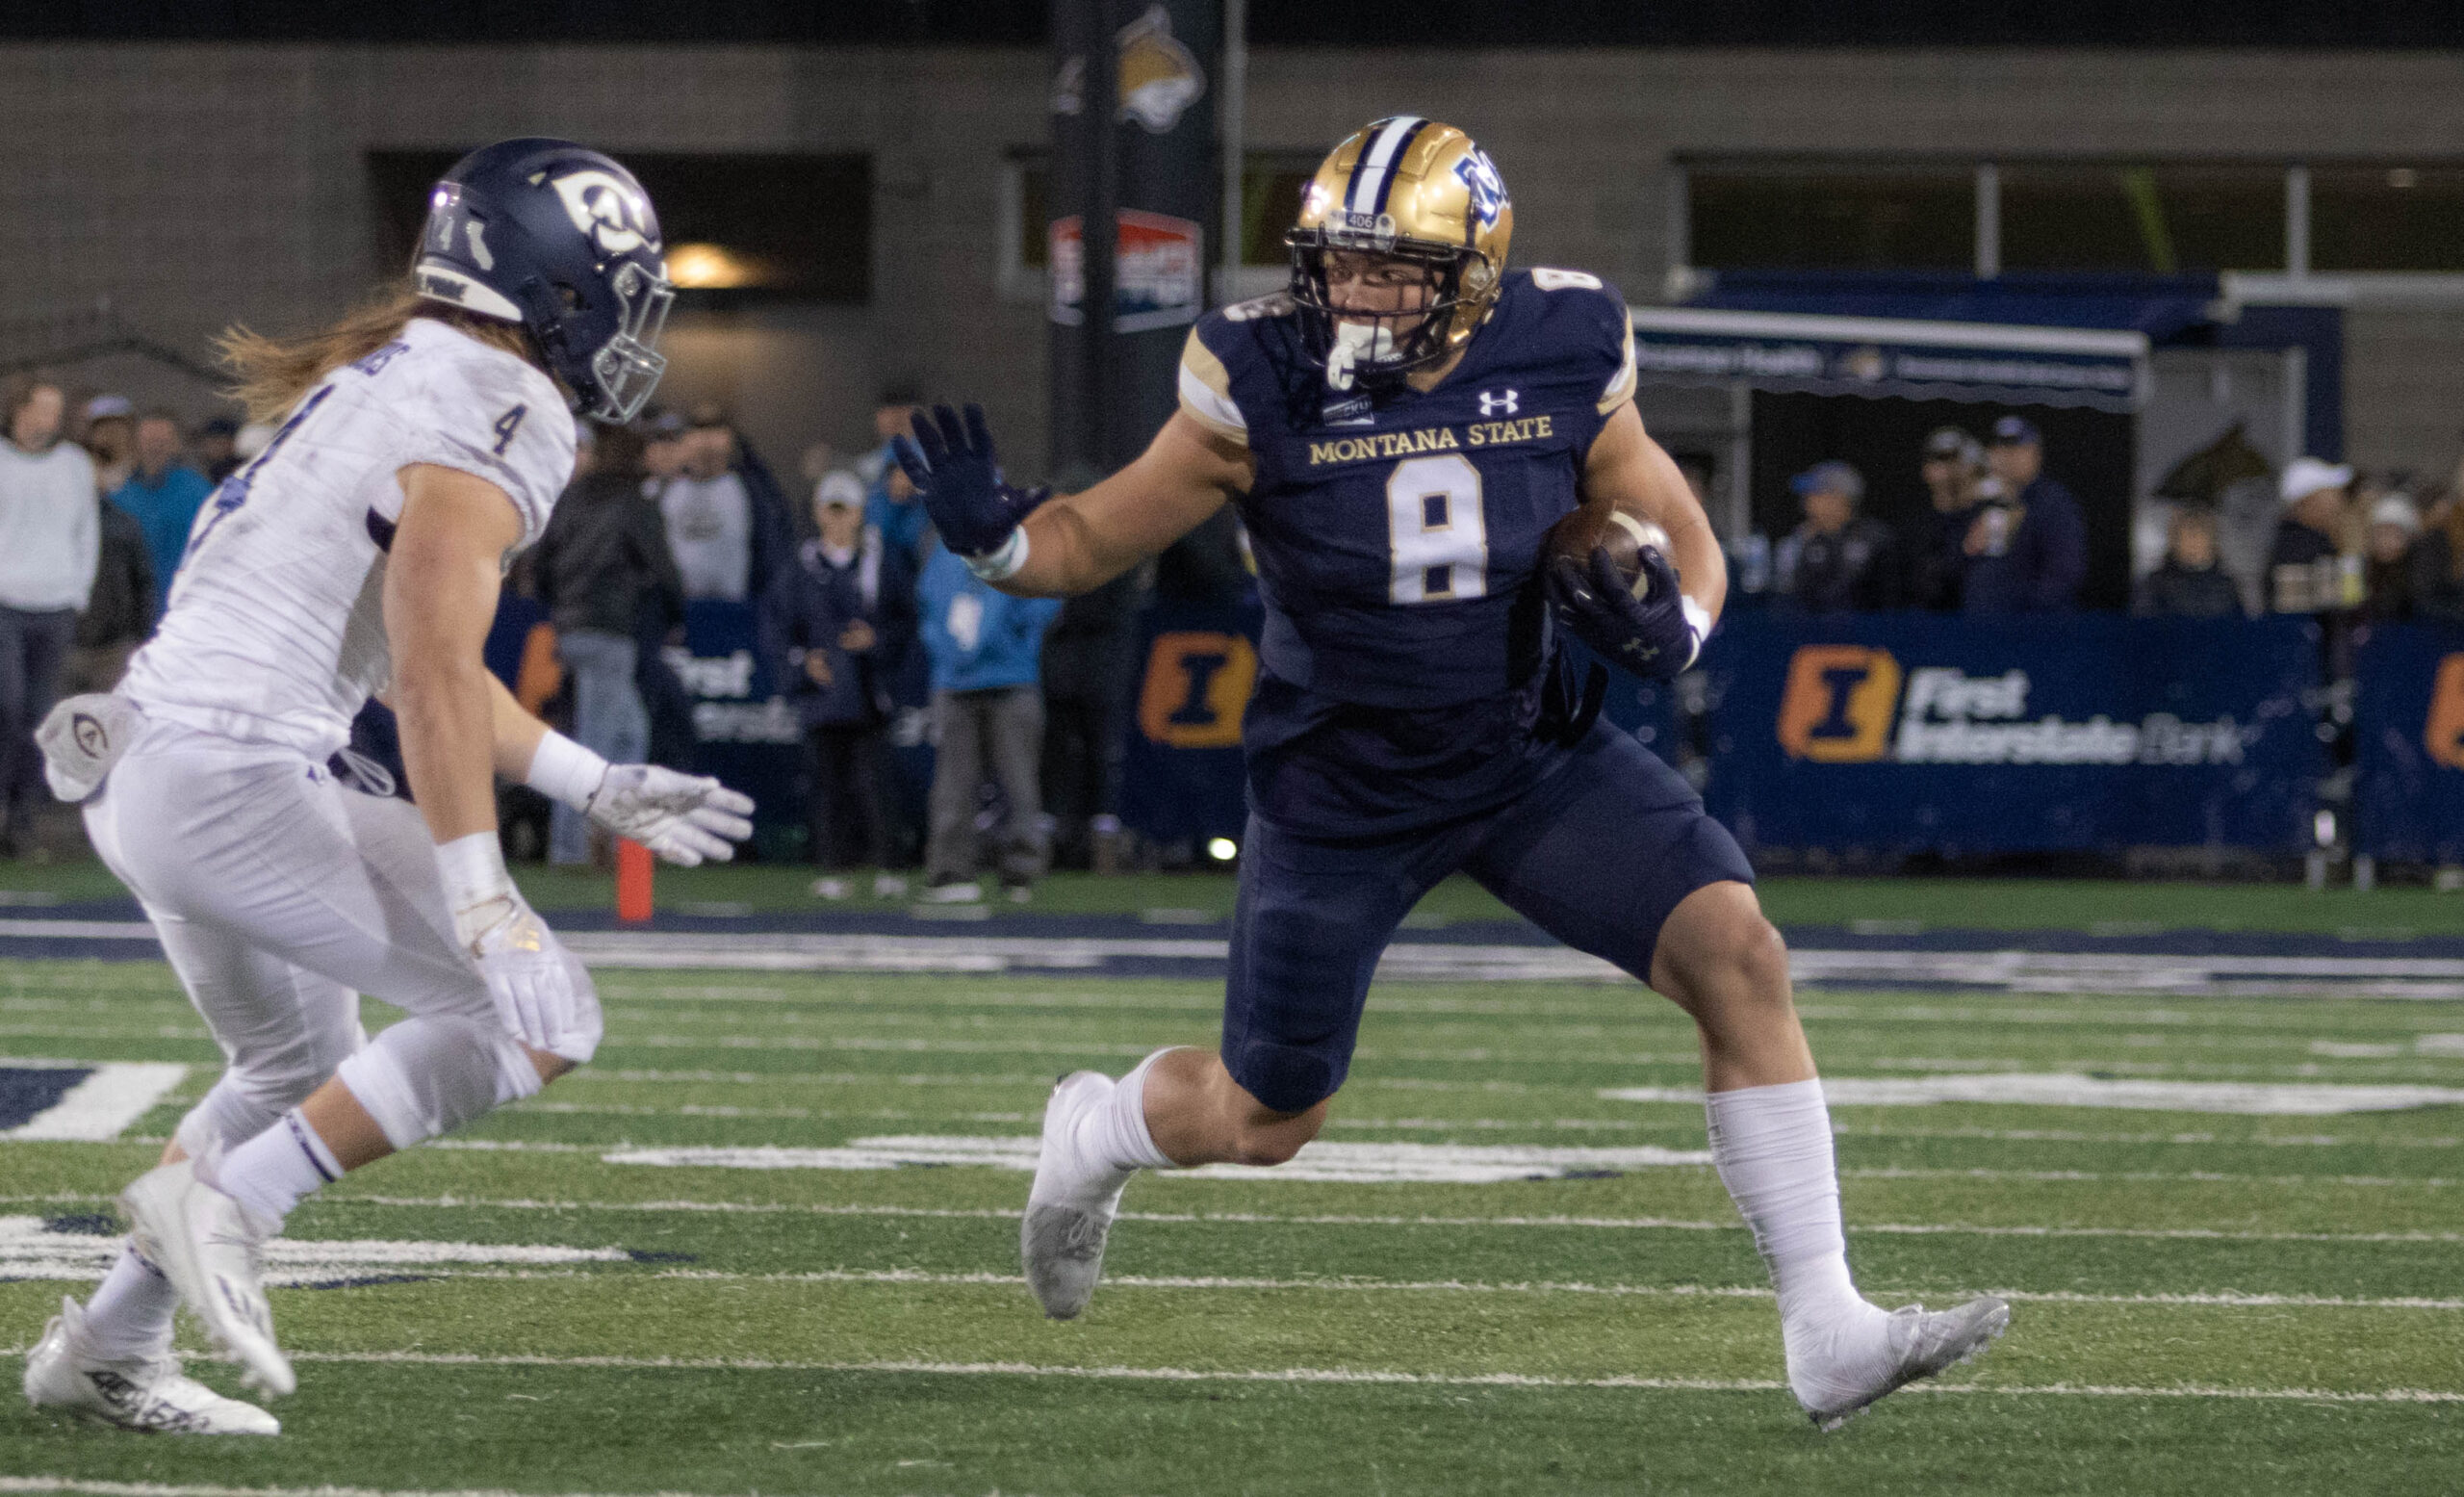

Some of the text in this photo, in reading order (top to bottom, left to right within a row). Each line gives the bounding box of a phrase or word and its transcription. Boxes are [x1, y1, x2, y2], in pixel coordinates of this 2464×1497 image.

[1348, 217, 1374, 228] 406
[494, 403, 527, 456] 4
[1310, 415, 1553, 465] MONTANA STATE
[1386, 452, 1489, 606] 8
[1907, 666, 2031, 719] First
[1896, 712, 2140, 763] Interstate
